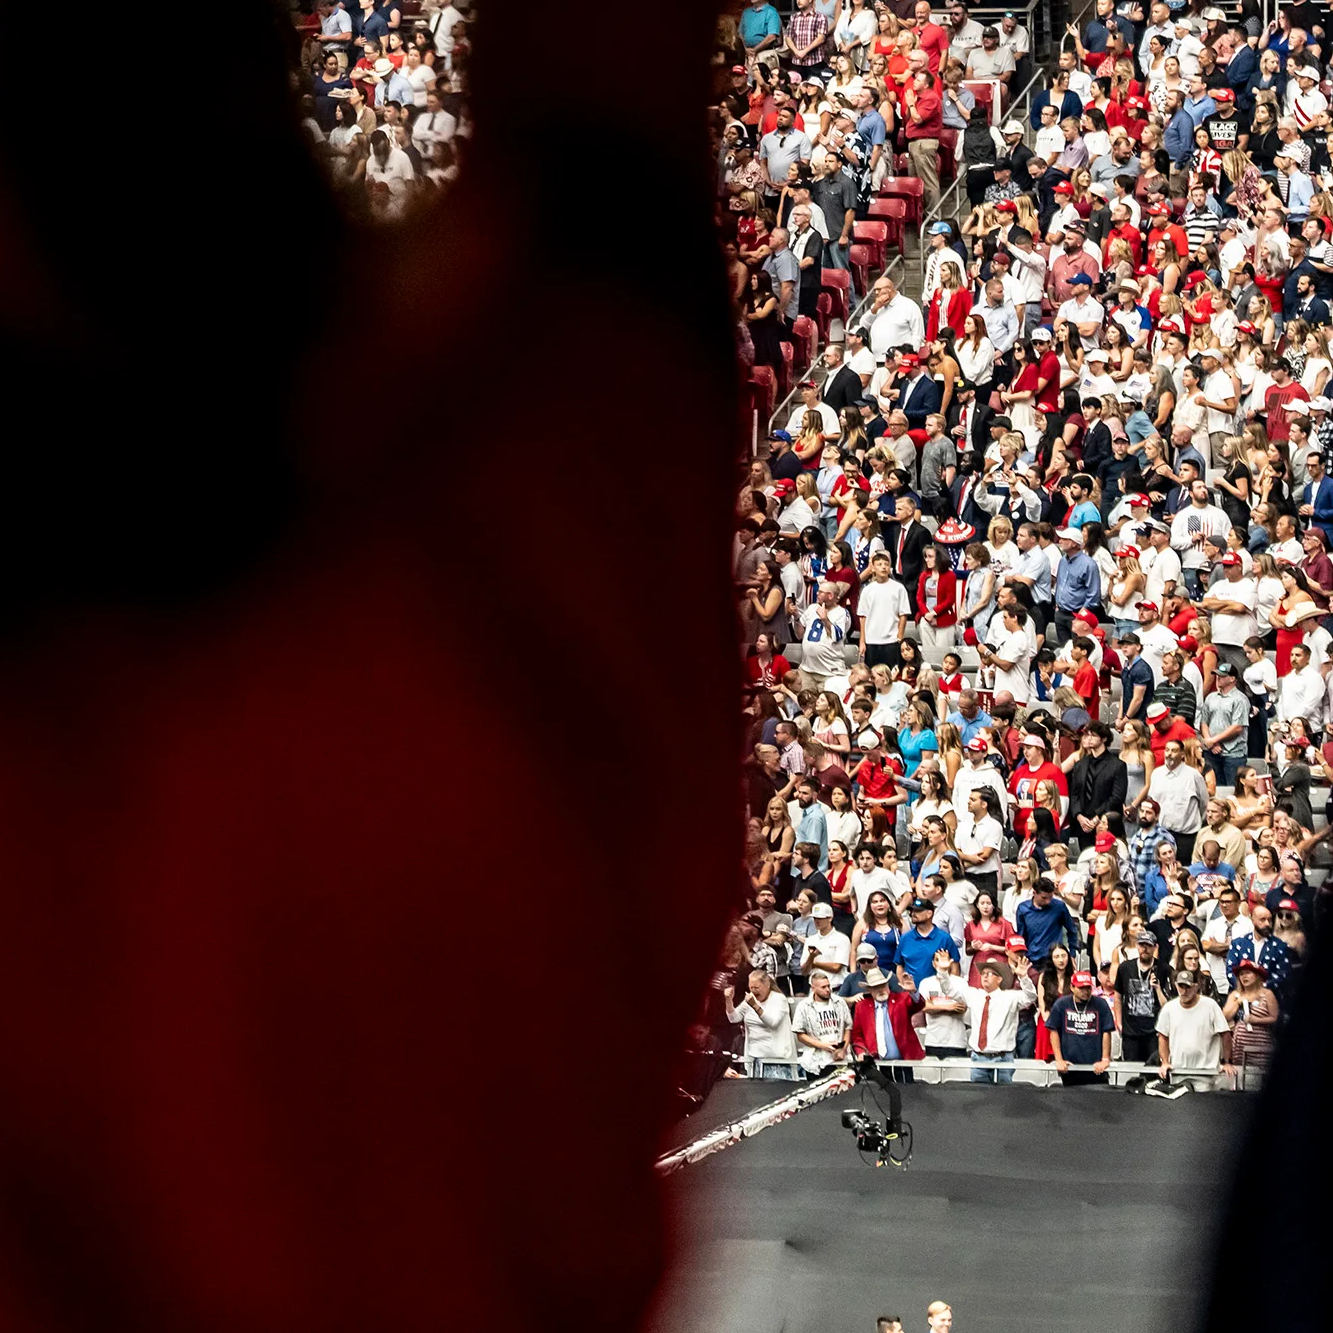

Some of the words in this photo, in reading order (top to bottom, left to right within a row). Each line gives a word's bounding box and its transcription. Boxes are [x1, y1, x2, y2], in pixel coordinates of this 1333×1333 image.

[1211, 122, 1236, 131] BLACK
[807, 617, 824, 643] 8
[1066, 1011, 1096, 1022] TRUMP
